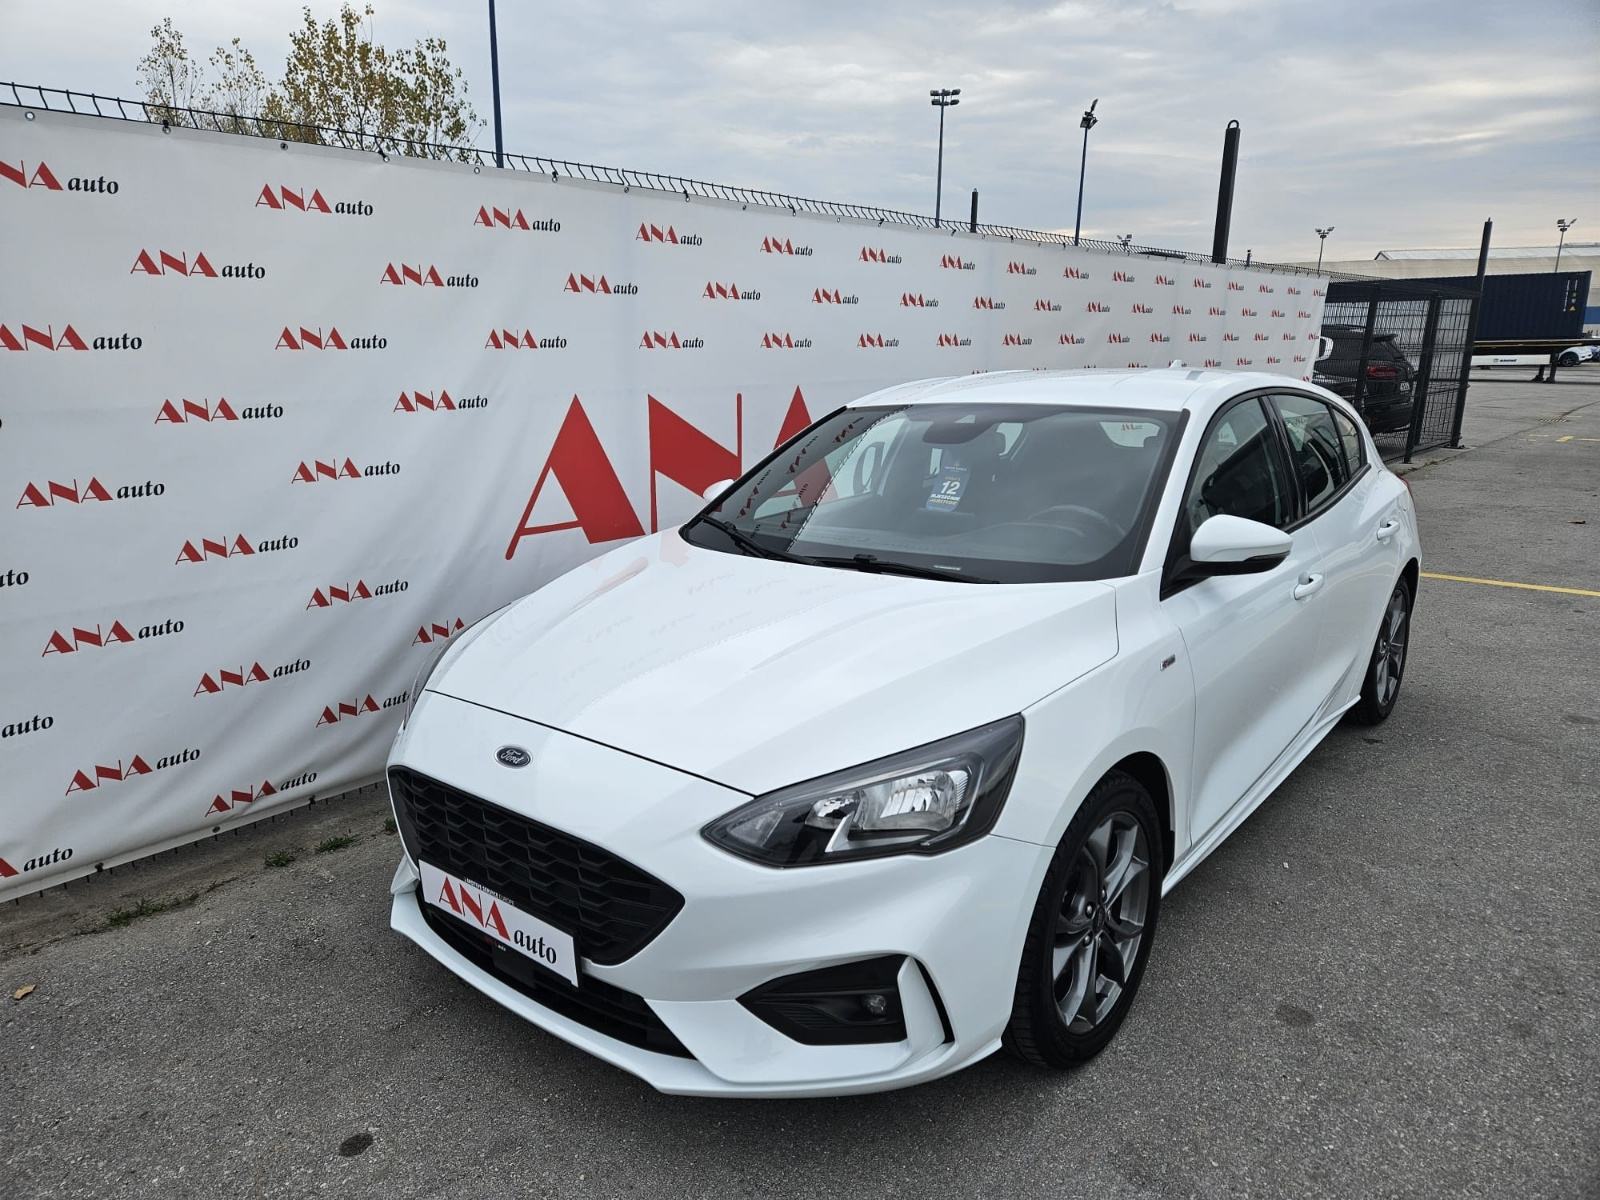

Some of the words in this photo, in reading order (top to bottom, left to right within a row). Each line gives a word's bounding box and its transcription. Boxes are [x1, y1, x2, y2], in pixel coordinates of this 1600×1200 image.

[0, 160, 63, 190] NA
[68, 176, 118, 194] auto
[256, 184, 332, 213] ANA
[335, 201, 373, 216] auto
[474, 206, 530, 230] ANA
[533, 219, 560, 232] auto
[636, 223, 679, 244] ANA
[681, 234, 702, 246] auto
[760, 237, 794, 255] ANA
[795, 246, 812, 256] auto
[859, 246, 886, 263] ANA
[887, 255, 901, 264] auto
[130, 249, 218, 277] ANA
[222, 263, 265, 278] auto
[940, 255, 962, 269] ANA
[1007, 262, 1025, 275] ANA
[1063, 266, 1079, 279] ANA
[380, 263, 444, 287] ANA
[447, 274, 478, 287] auto
[564, 273, 611, 294] ANA
[614, 283, 638, 295] auto
[1112, 271, 1126, 284] ANA
[703, 282, 740, 300] ANA
[741, 290, 760, 300] auto
[812, 288, 841, 304] ANA
[843, 295, 858, 304] auto
[900, 293, 924, 307] ANA
[973, 297, 993, 309] ANA
[1034, 300, 1051, 311] ANA
[1087, 301, 1101, 313] ANA
[1132, 303, 1145, 314] ANA
[0, 324, 89, 351] ANA
[93, 333, 142, 350] auto
[275, 327, 348, 350] ANA
[351, 335, 387, 349] auto
[485, 329, 537, 349] ANA
[540, 336, 567, 348] auto
[639, 331, 681, 349] ANA
[683, 338, 703, 348] auto
[761, 333, 793, 348] ANA
[795, 338, 811, 348] auto
[857, 334, 883, 347] ANA
[885, 338, 899, 347] auto
[937, 334, 958, 346] ANA
[1003, 334, 1021, 346] ANA
[1058, 333, 1075, 345] ANA
[1108, 333, 1121, 343] ANA
[155, 398, 239, 424] ANA
[242, 403, 283, 419] auto
[394, 390, 456, 412] ANA
[459, 395, 487, 409] auto
[292, 458, 361, 484] ANA
[365, 461, 400, 476] auto
[506, 385, 839, 560] ANA
[16, 477, 113, 509] ANA
[117, 481, 164, 499] auto
[941, 481, 960, 495] 12
[175, 534, 255, 565] ANA
[259, 535, 298, 552] auto
[306, 580, 372, 610] ANA
[375, 580, 408, 596] auto
[42, 620, 135, 657] ANA
[139, 619, 184, 639] auto
[194, 662, 270, 697] ANA
[273, 659, 310, 678] auto
[316, 694, 381, 727] ANA
[383, 691, 409, 708] aut
[2, 715, 53, 738] auto
[500, 749, 524, 765] Ford
[66, 755, 153, 796] ANA
[157, 749, 200, 769] auto
[205, 780, 278, 817] ANA
[281, 770, 317, 791] auto
[24, 848, 73, 872] auto
[439, 875, 511, 941] ANA
[514, 929, 557, 964] auto
